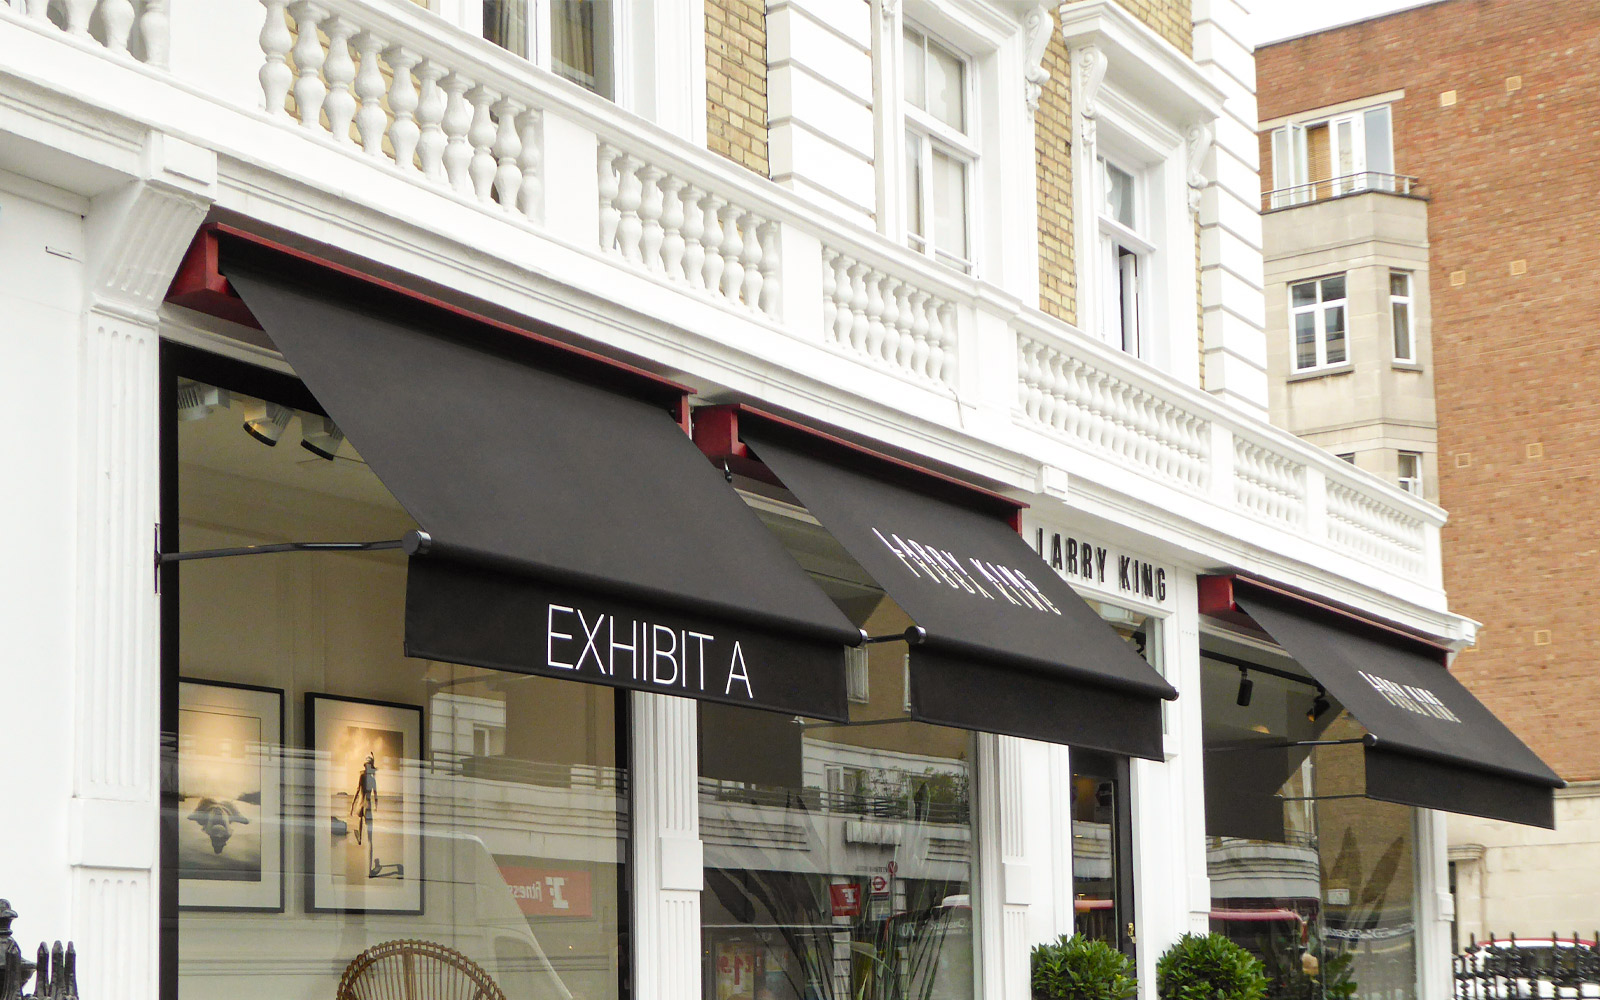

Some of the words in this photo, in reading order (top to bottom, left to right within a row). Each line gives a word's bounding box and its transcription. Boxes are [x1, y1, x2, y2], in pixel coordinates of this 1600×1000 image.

[1038, 527, 1107, 582] LARRY
[1120, 554, 1166, 602] KING
[547, 603, 714, 690] EXHIBIT
[725, 640, 753, 698] A
